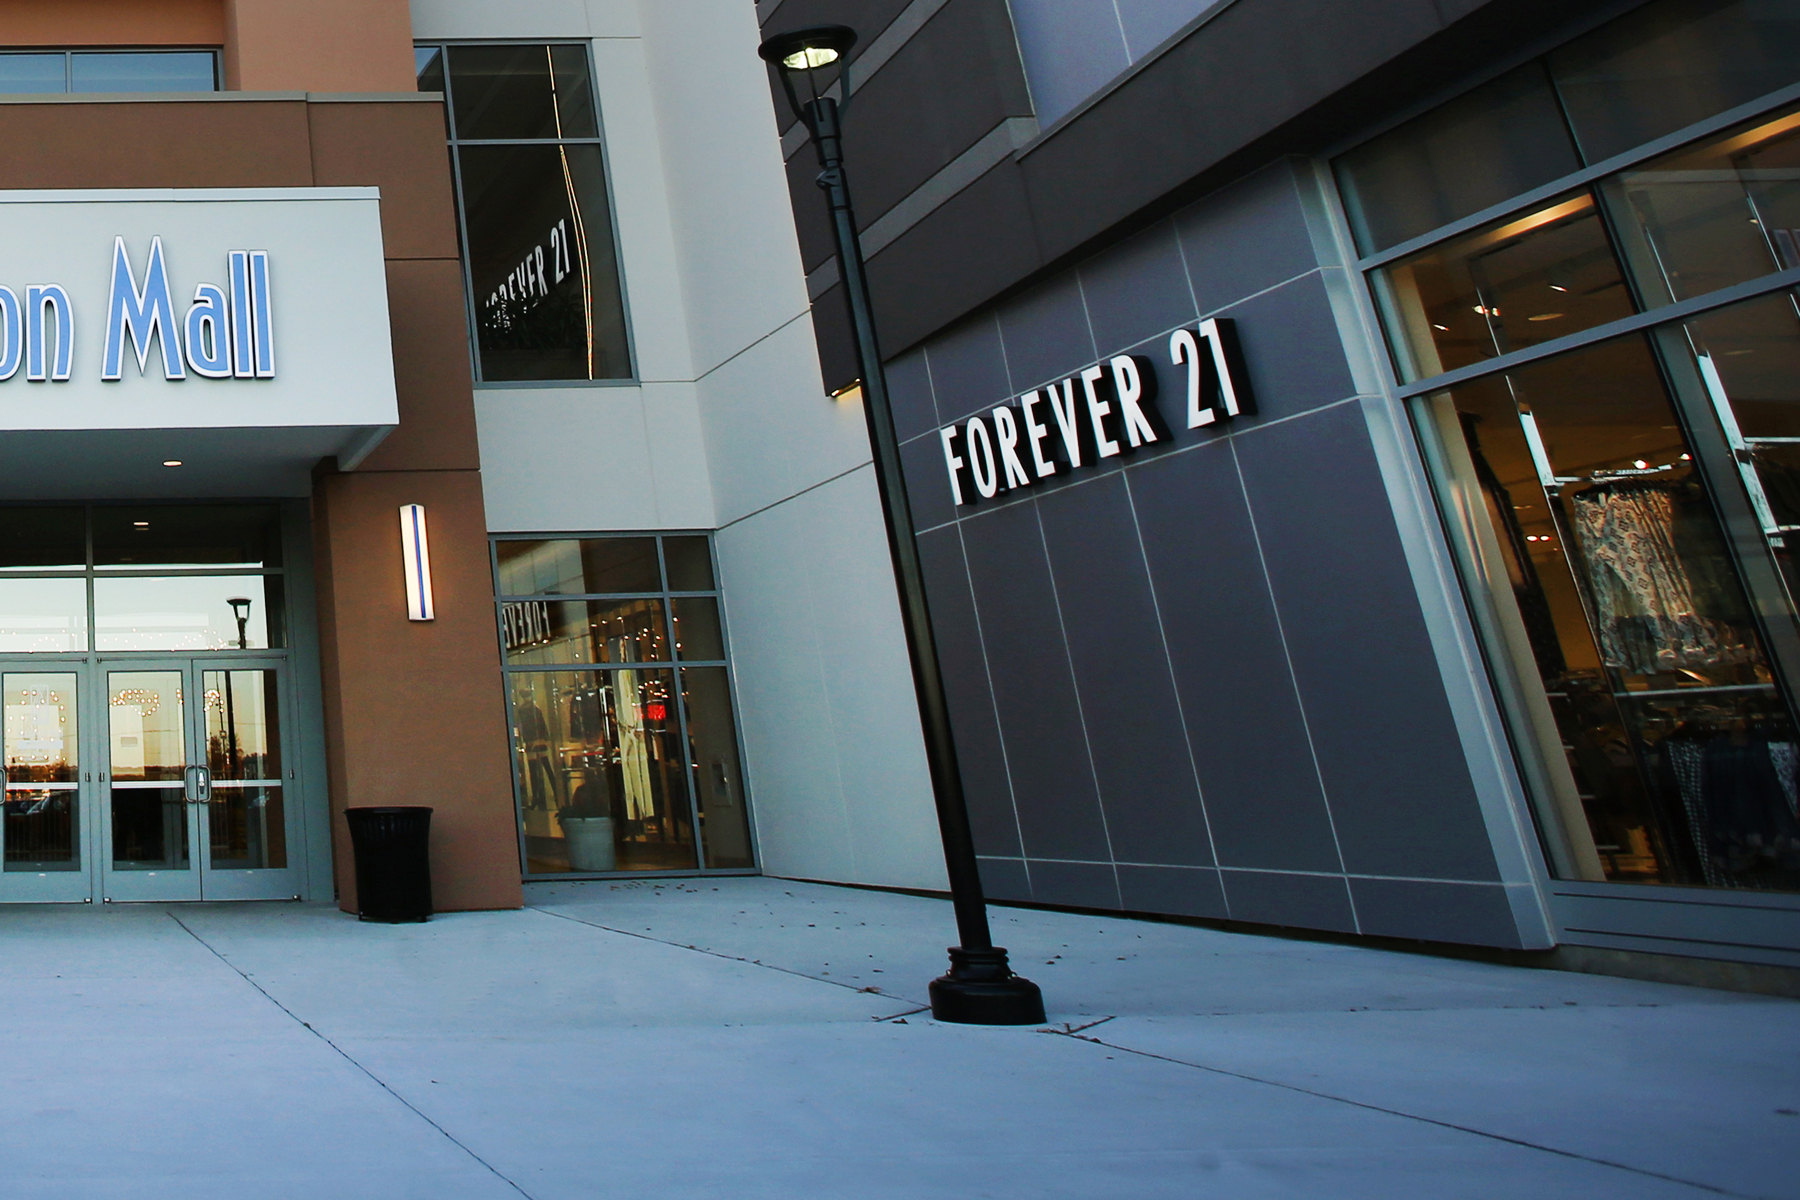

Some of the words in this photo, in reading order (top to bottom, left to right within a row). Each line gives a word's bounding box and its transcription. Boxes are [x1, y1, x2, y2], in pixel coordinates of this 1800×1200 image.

[101, 234, 276, 382] Mall
[484, 245, 549, 329] REVER
[551, 218, 571, 285] 21
[940, 354, 1158, 507] FOREVER
[1169, 317, 1241, 431] 21
